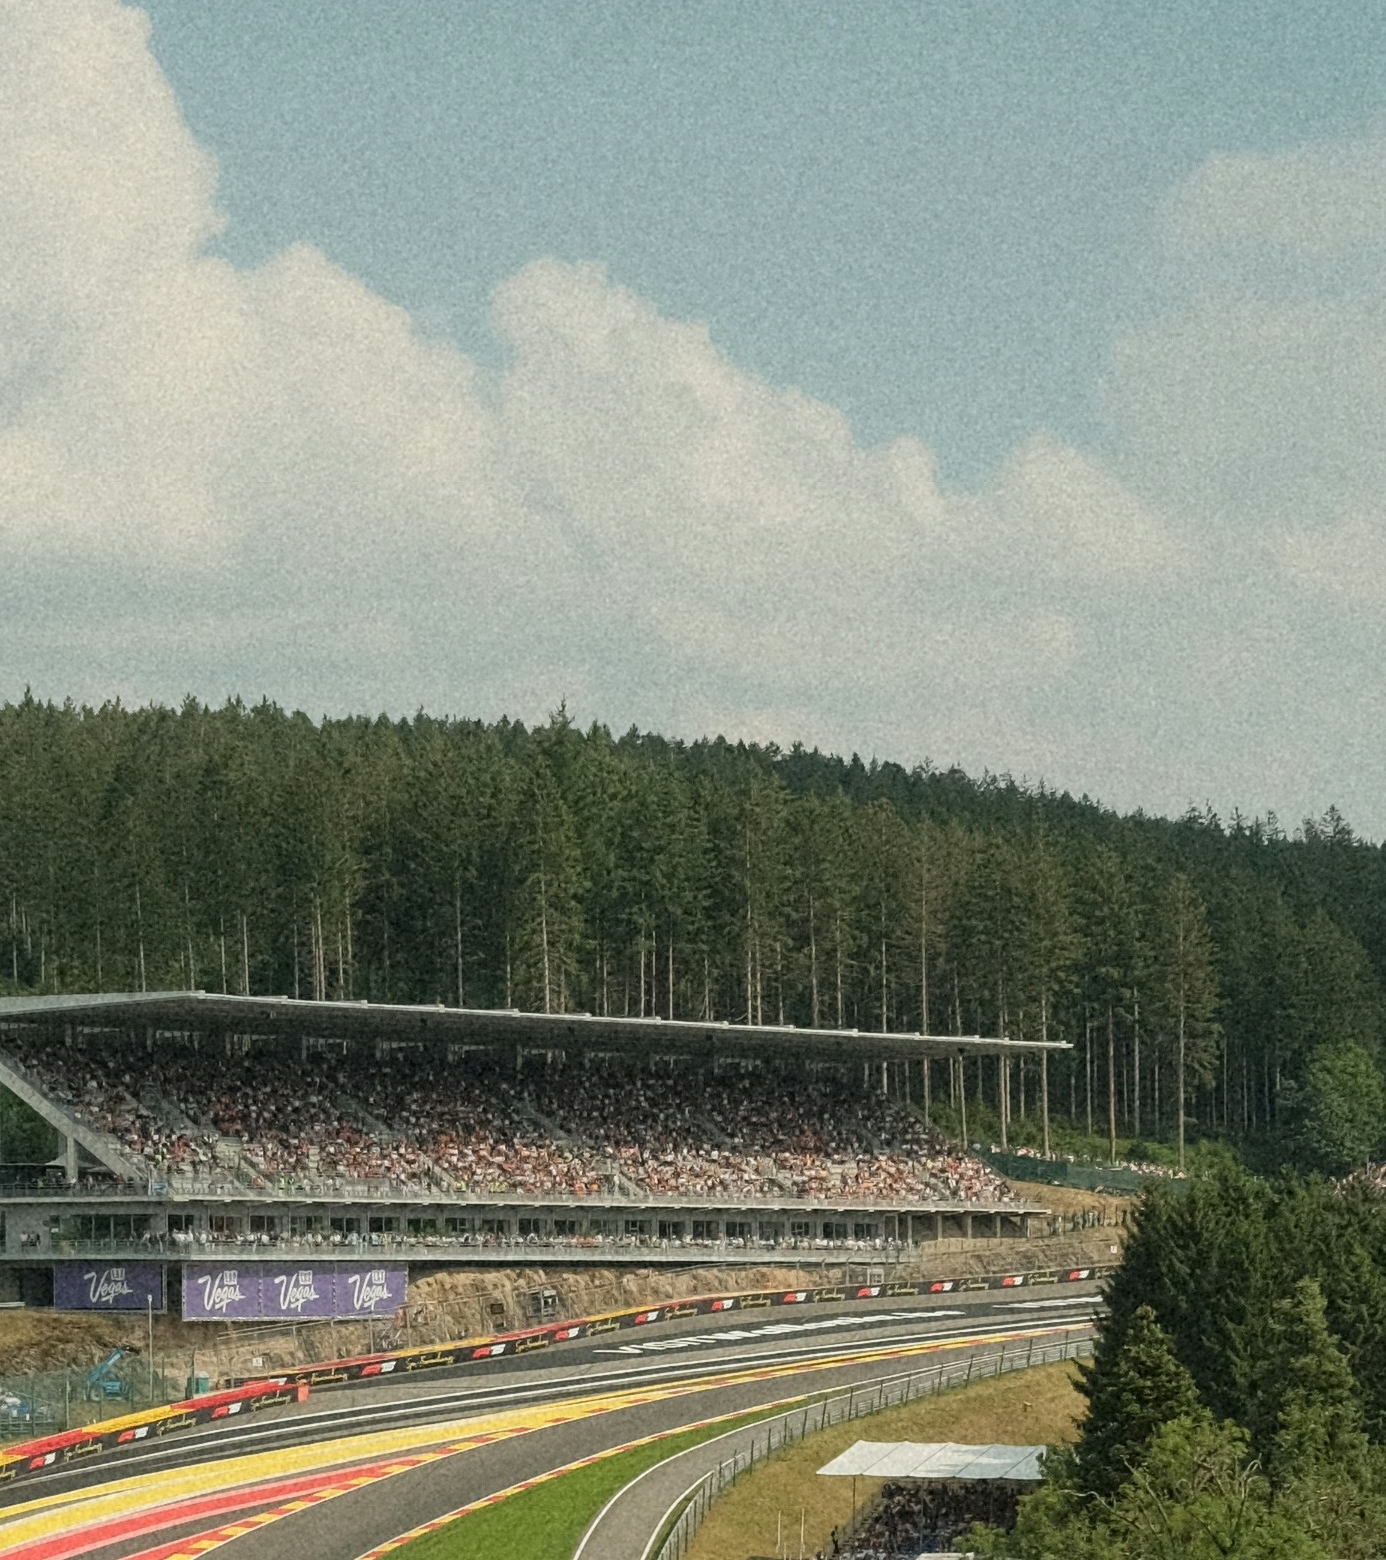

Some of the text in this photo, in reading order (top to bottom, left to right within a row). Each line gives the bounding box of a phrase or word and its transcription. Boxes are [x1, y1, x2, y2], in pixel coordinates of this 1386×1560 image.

[84, 1271, 133, 1304] Vegas
[198, 1274, 246, 1311] Vegas
[274, 1274, 319, 1311] Vegas
[348, 1273, 392, 1310] Vegas
